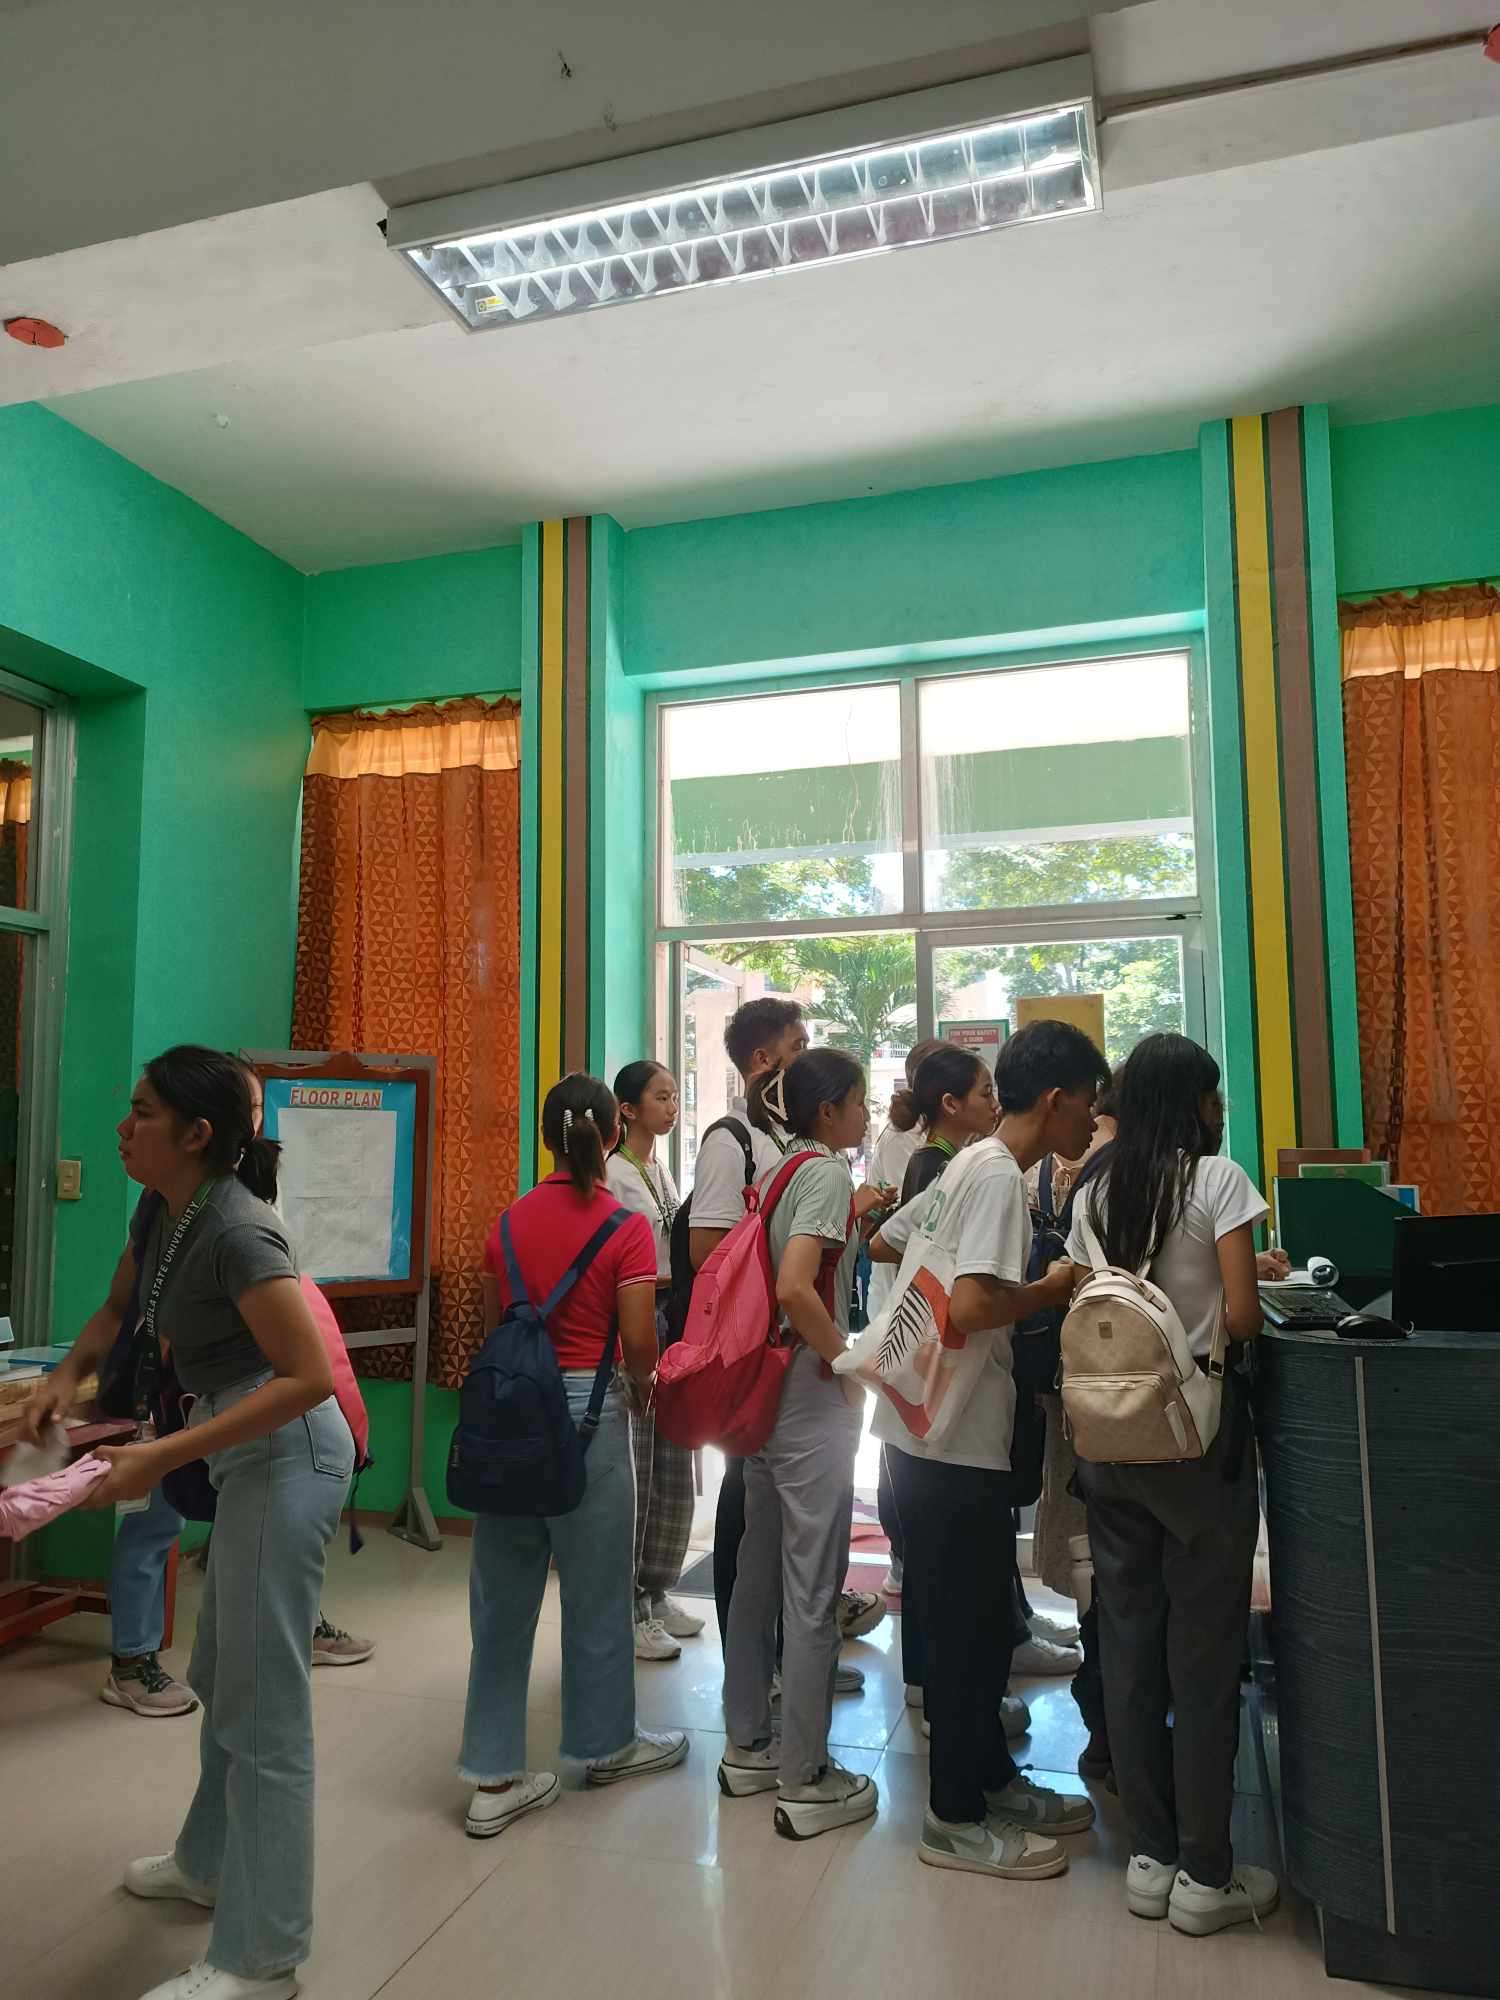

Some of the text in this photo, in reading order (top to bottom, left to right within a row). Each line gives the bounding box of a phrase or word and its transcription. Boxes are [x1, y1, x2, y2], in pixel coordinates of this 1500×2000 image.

[291, 1088, 381, 1107] FLOOR PLAN
[145, 1200, 200, 1338] ISABELA STATE UNIVERSITY
